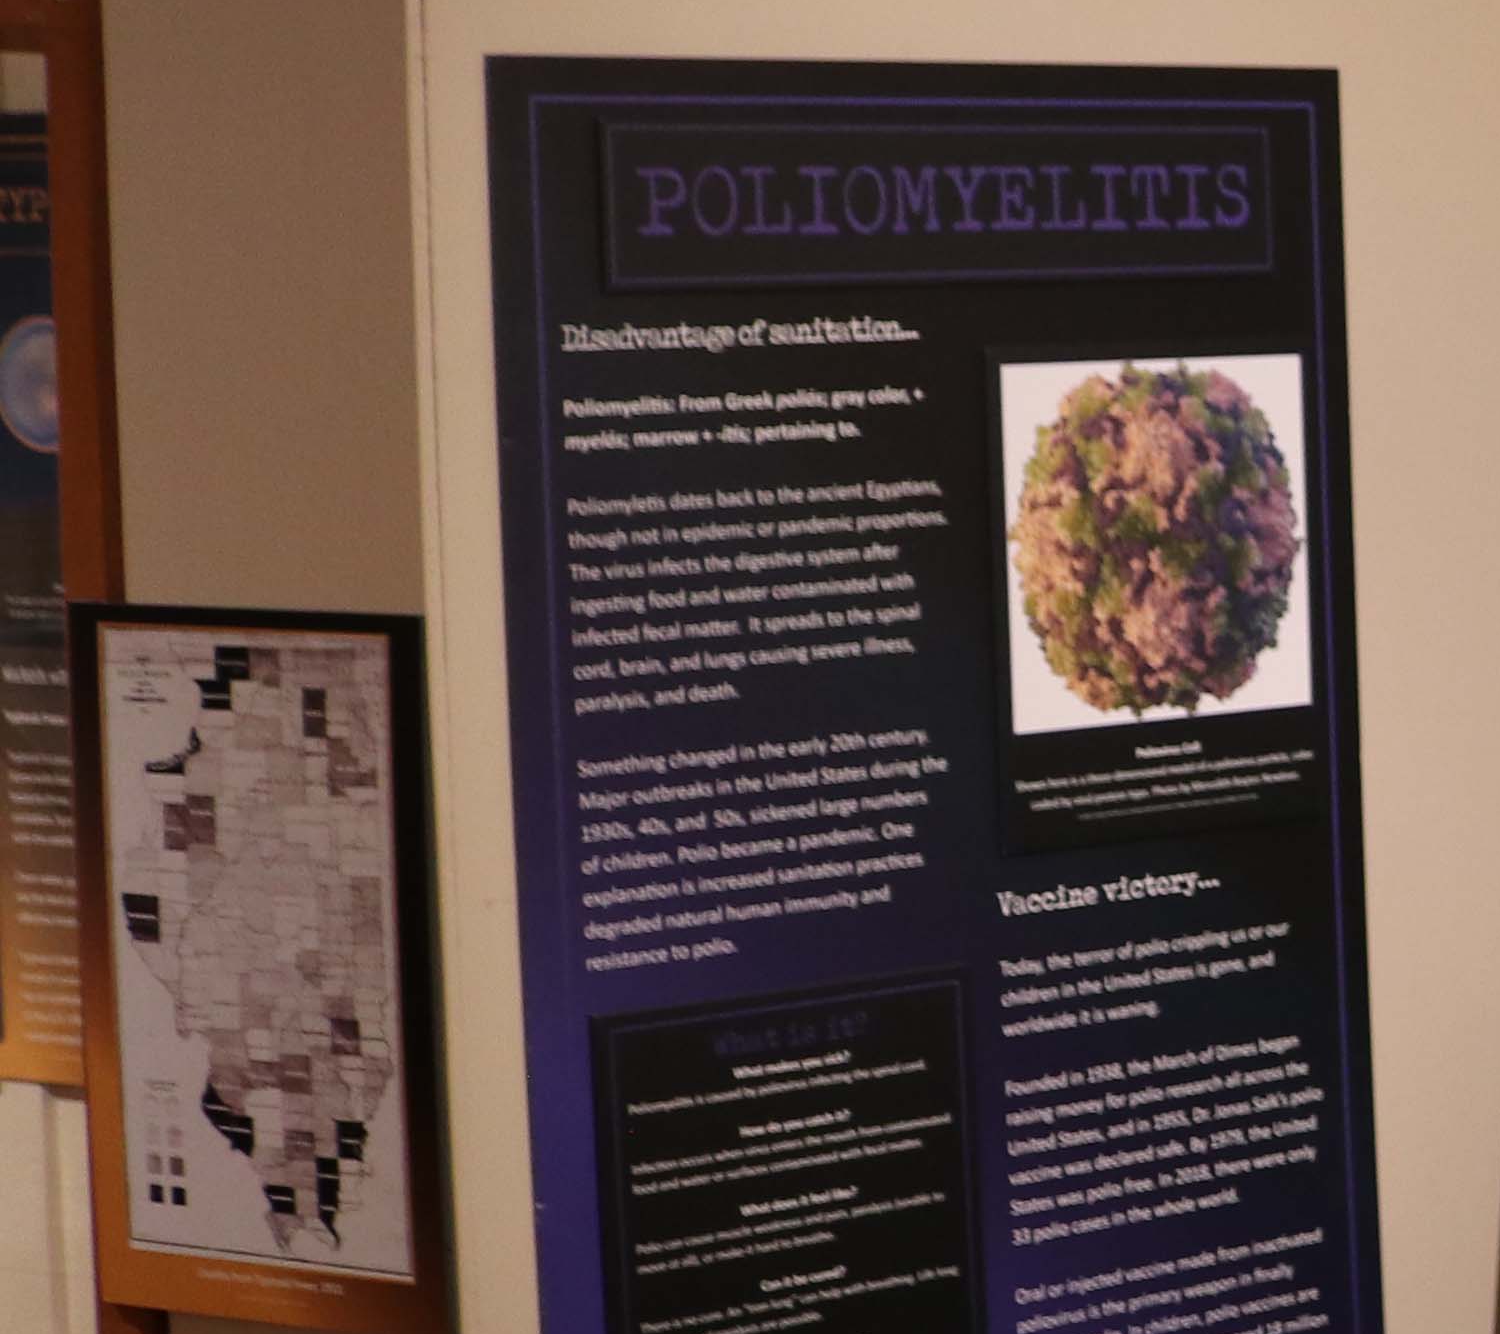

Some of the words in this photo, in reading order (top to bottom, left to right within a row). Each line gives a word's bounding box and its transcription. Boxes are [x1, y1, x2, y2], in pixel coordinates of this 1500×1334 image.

[637, 166, 1250, 235] POLIOMYELITIS
[562, 323, 735, 353] Disadvantage
[739, 318, 766, 346] of
[680, 394, 721, 412] From
[724, 390, 774, 410] Greek
[831, 390, 865, 412] gray
[633, 430, 699, 447] marrow
[754, 420, 837, 444] pertaining
[669, 491, 713, 510] dates
[716, 489, 753, 508] back
[756, 488, 774, 505] to
[777, 486, 803, 504] the
[806, 484, 863, 502] ancient
[568, 529, 627, 551] though
[630, 528, 658, 545] not
[662, 525, 678, 543] in
[681, 523, 754, 545] epidemic
[756, 522, 773, 538] or
[777, 517, 853, 539] pandemic
[569, 563, 601, 581] The
[603, 560, 644, 579] virus
[647, 557, 701, 576] infects
[704, 555, 732, 573] the
[734, 550, 803, 572] digestive
[806, 548, 860, 568] system
[862, 542, 899, 560] after
[570, 596, 645, 618] ingesting
[648, 590, 687, 608] food
[689, 589, 720, 606] and
[723, 586, 768, 603] water
[771, 576, 877, 599] contaminated
[879, 572, 914, 591] with
[571, 627, 640, 646] infected
[642, 623, 680, 643] fecal
[749, 617, 761, 633] It
[764, 610, 826, 634] spreads
[827, 611, 844, 626] to
[847, 608, 873, 624] the
[876, 602, 921, 623] spinal
[996, 884, 1098, 917] Vaccine
